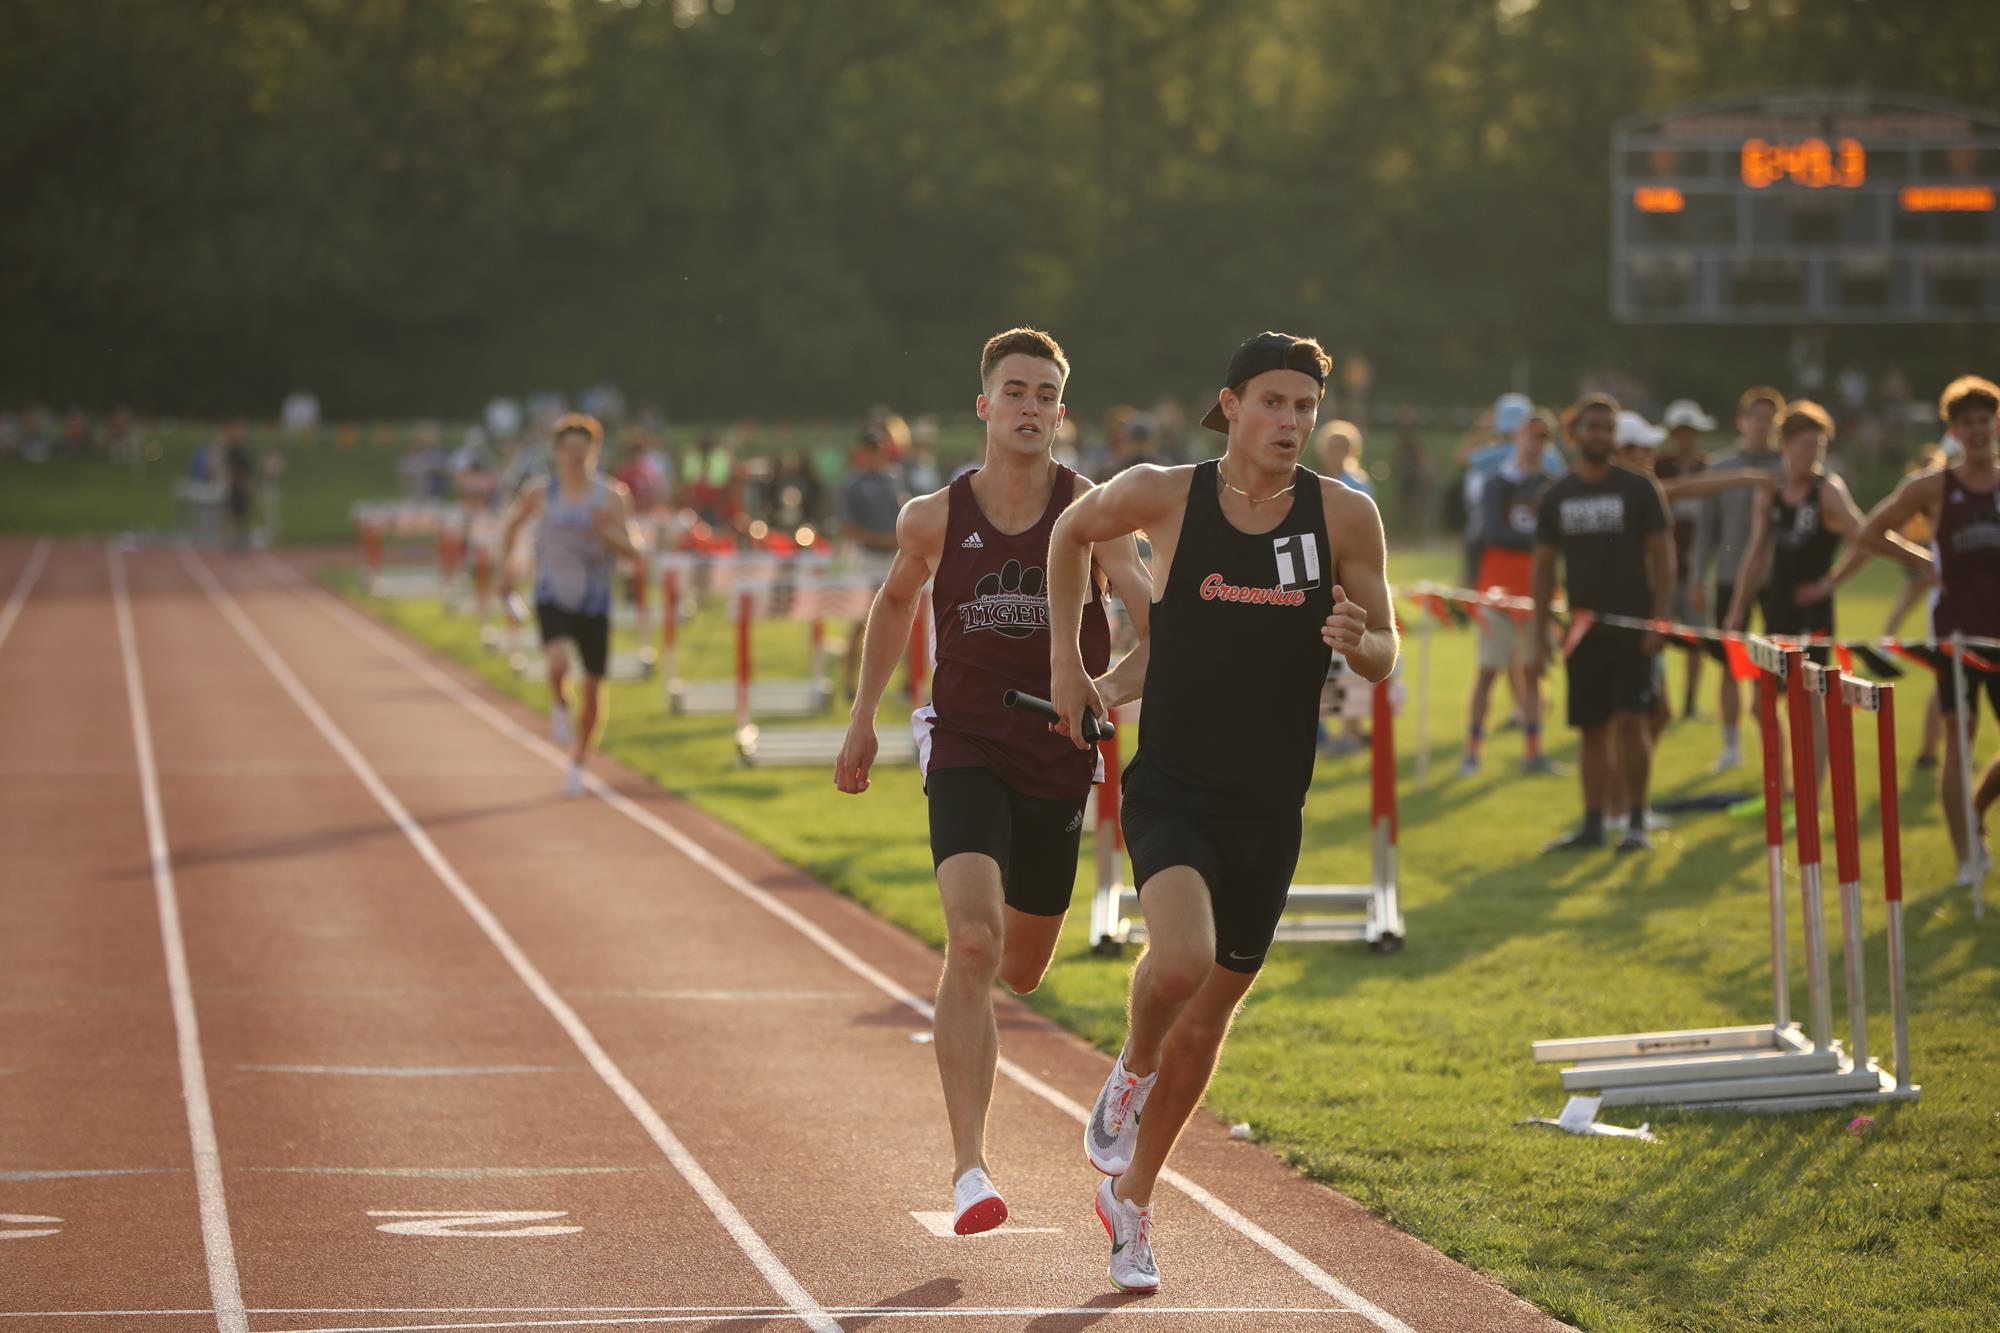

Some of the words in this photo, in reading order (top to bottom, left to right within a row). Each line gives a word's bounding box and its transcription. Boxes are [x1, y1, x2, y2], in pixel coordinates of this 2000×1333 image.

[961, 541, 984, 549] adidas
[1276, 535, 1319, 591] 1
[960, 601, 1050, 631] TIGER
[366, 1210, 585, 1238] 2
